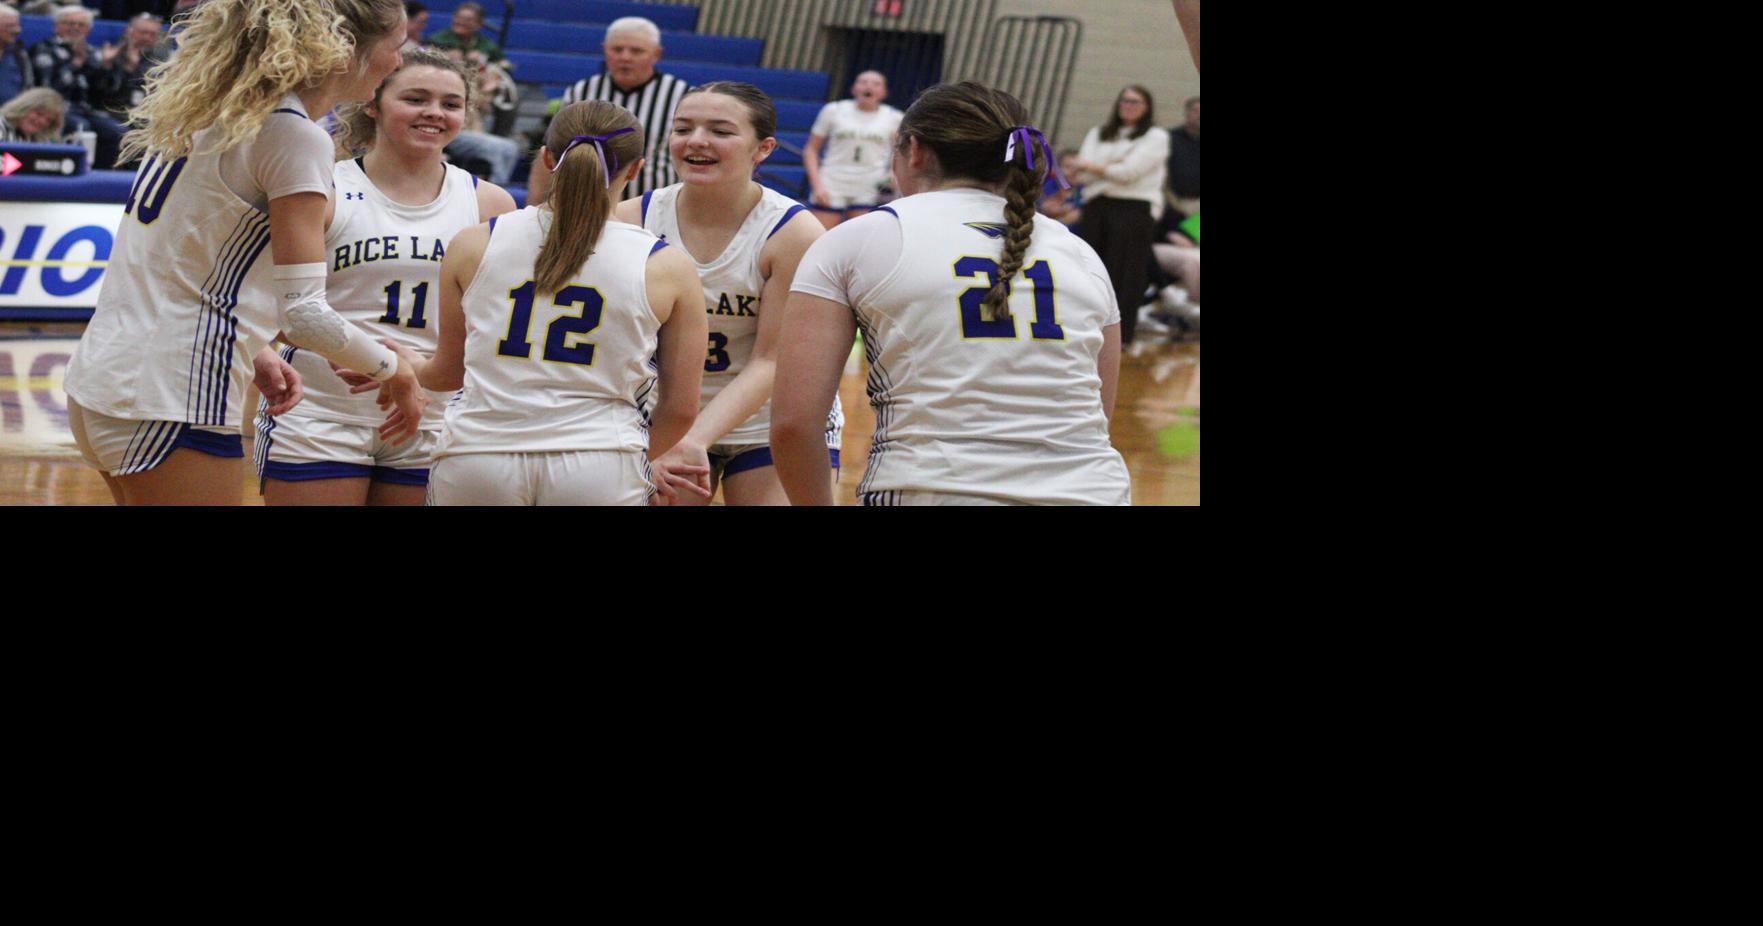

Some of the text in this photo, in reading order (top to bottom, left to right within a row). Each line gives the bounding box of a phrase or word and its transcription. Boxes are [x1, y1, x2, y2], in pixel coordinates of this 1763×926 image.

[0, 224, 114, 298] IO
[333, 235, 446, 272] RICE LA
[378, 279, 430, 329] 11
[706, 291, 762, 318] AK
[951, 253, 1068, 342] 21
[496, 278, 607, 368] 12
[703, 331, 732, 373] 3
